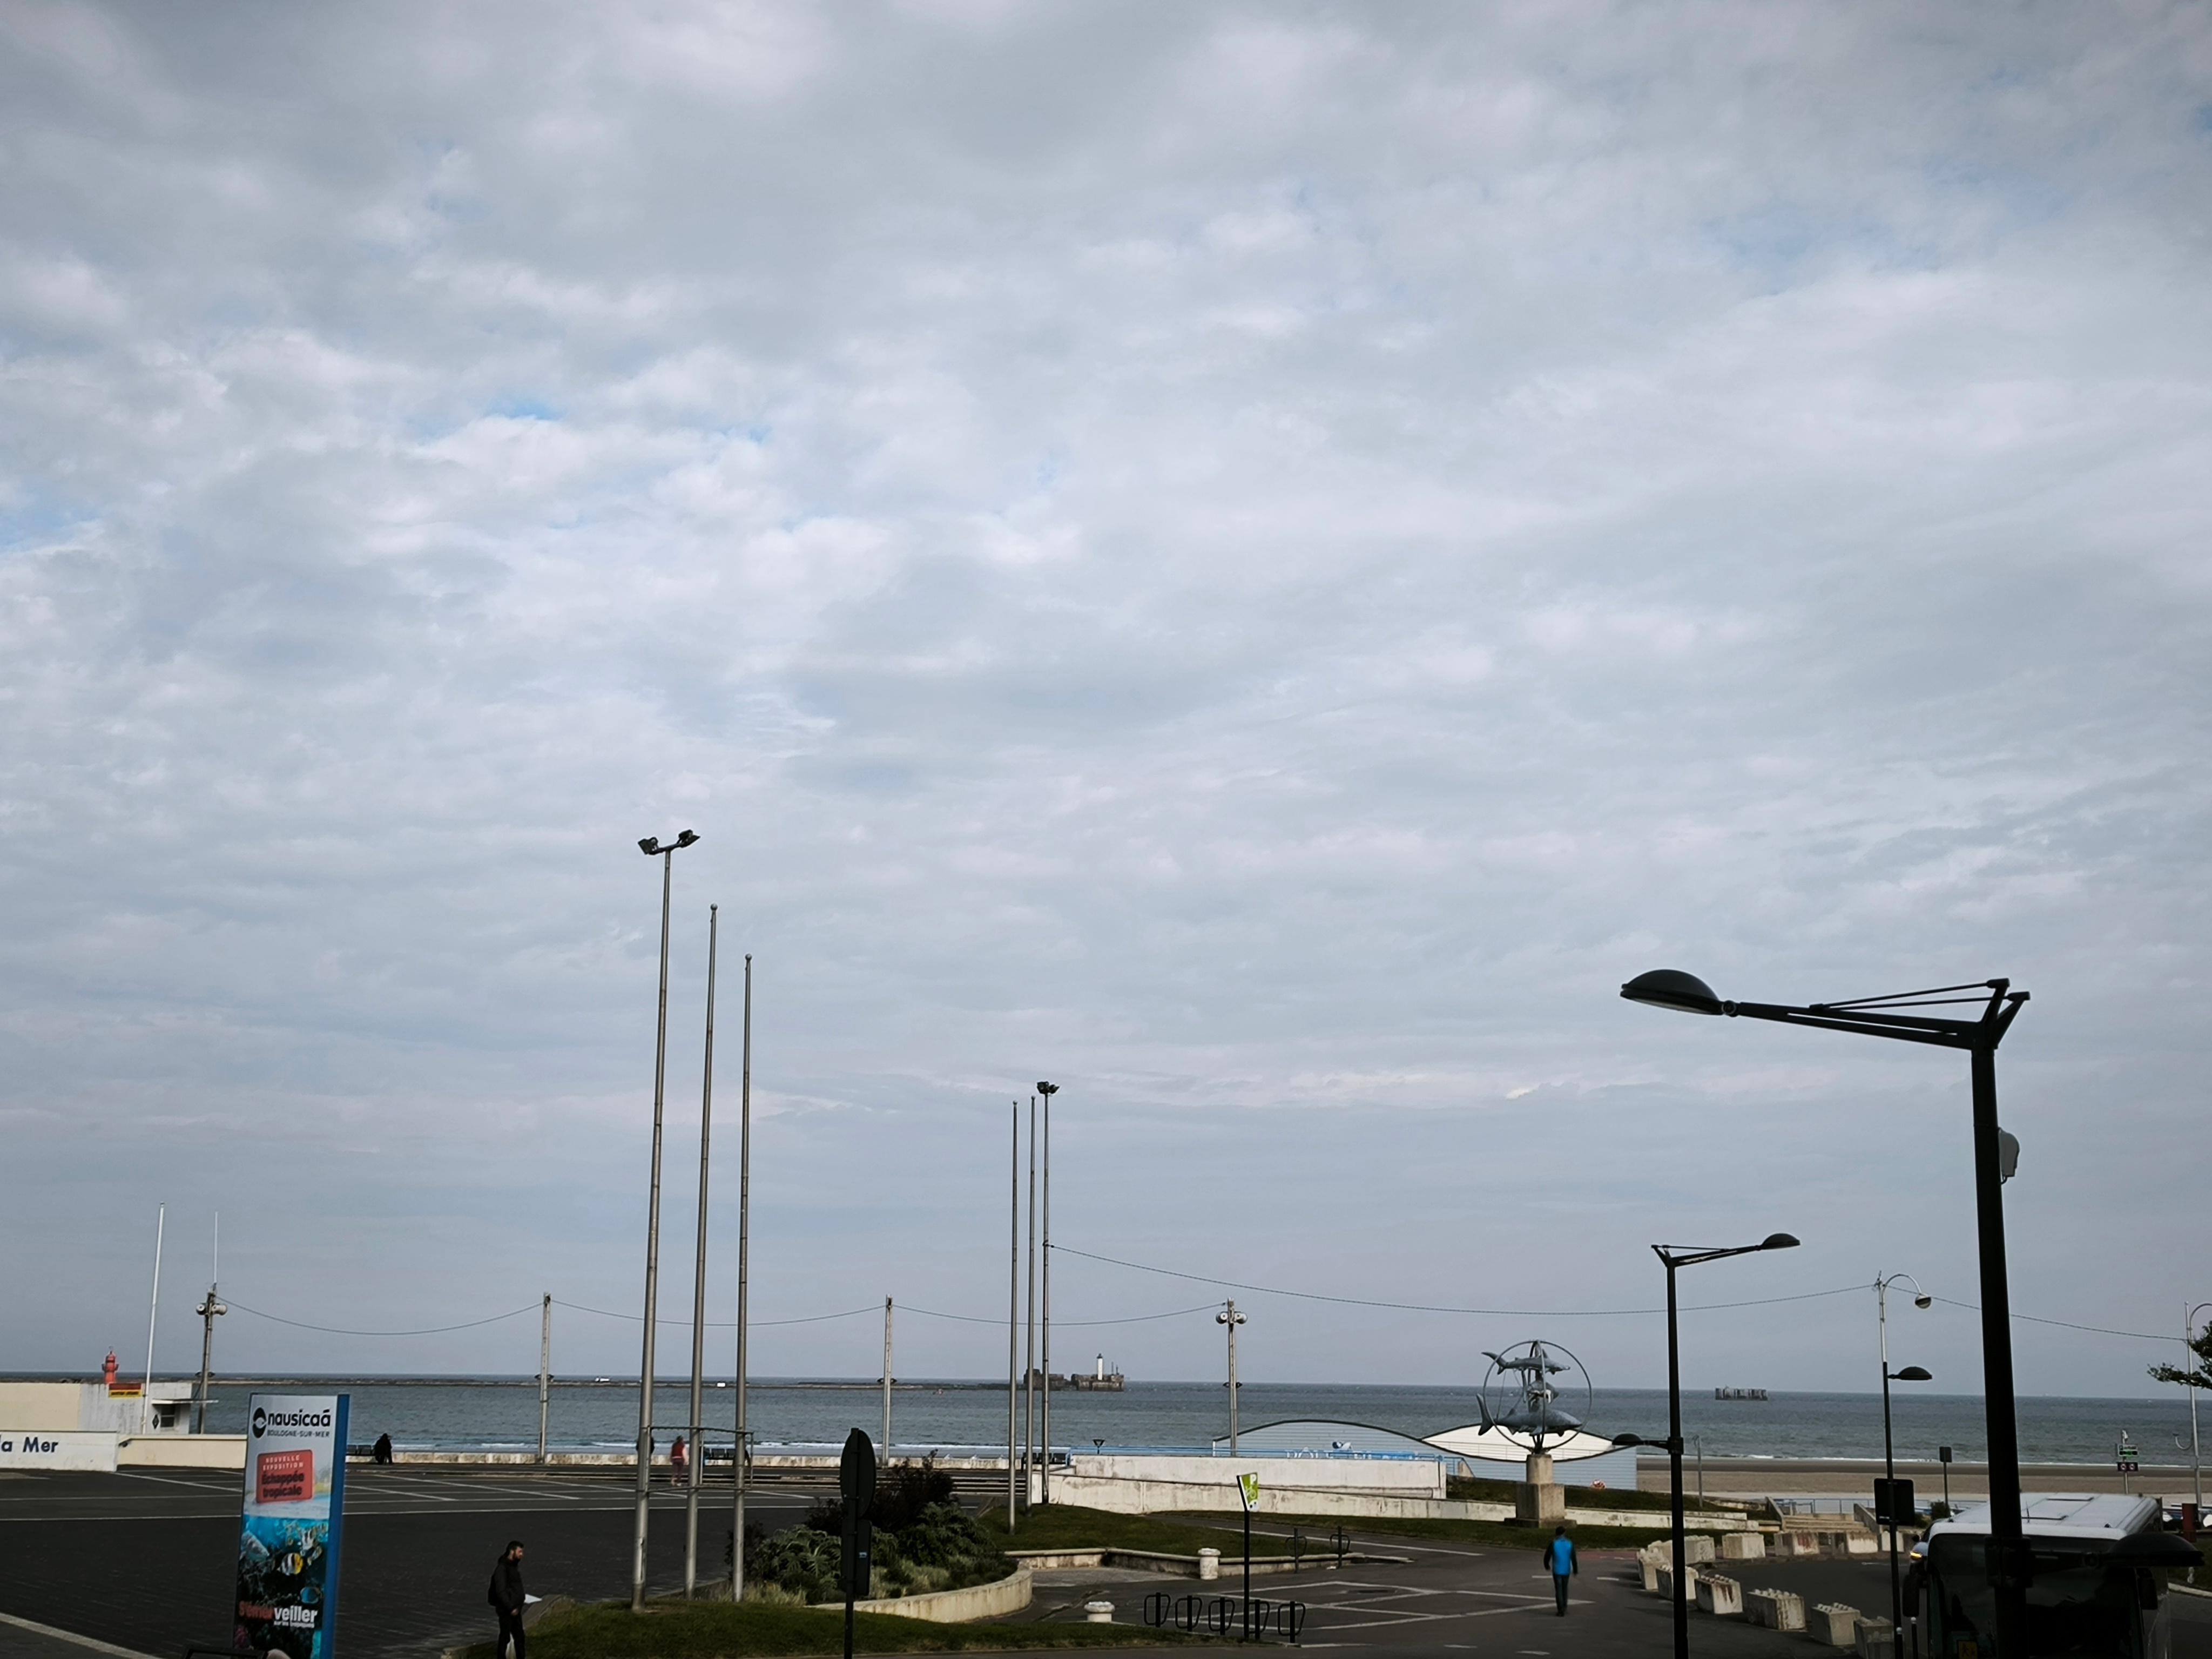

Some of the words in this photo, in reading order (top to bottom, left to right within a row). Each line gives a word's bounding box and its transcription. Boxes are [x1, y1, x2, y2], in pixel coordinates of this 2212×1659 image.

[267, 1429, 330, 1438] BOULOGNE-SUR-MER
[23, 1437, 59, 1452] Mer
[266, 1455, 300, 1463] NOUVELLE
[263, 1462, 304, 1471] EXPOSITION
[262, 1470, 305, 1487] Échappée
[263, 1485, 302, 1499] tropicale
